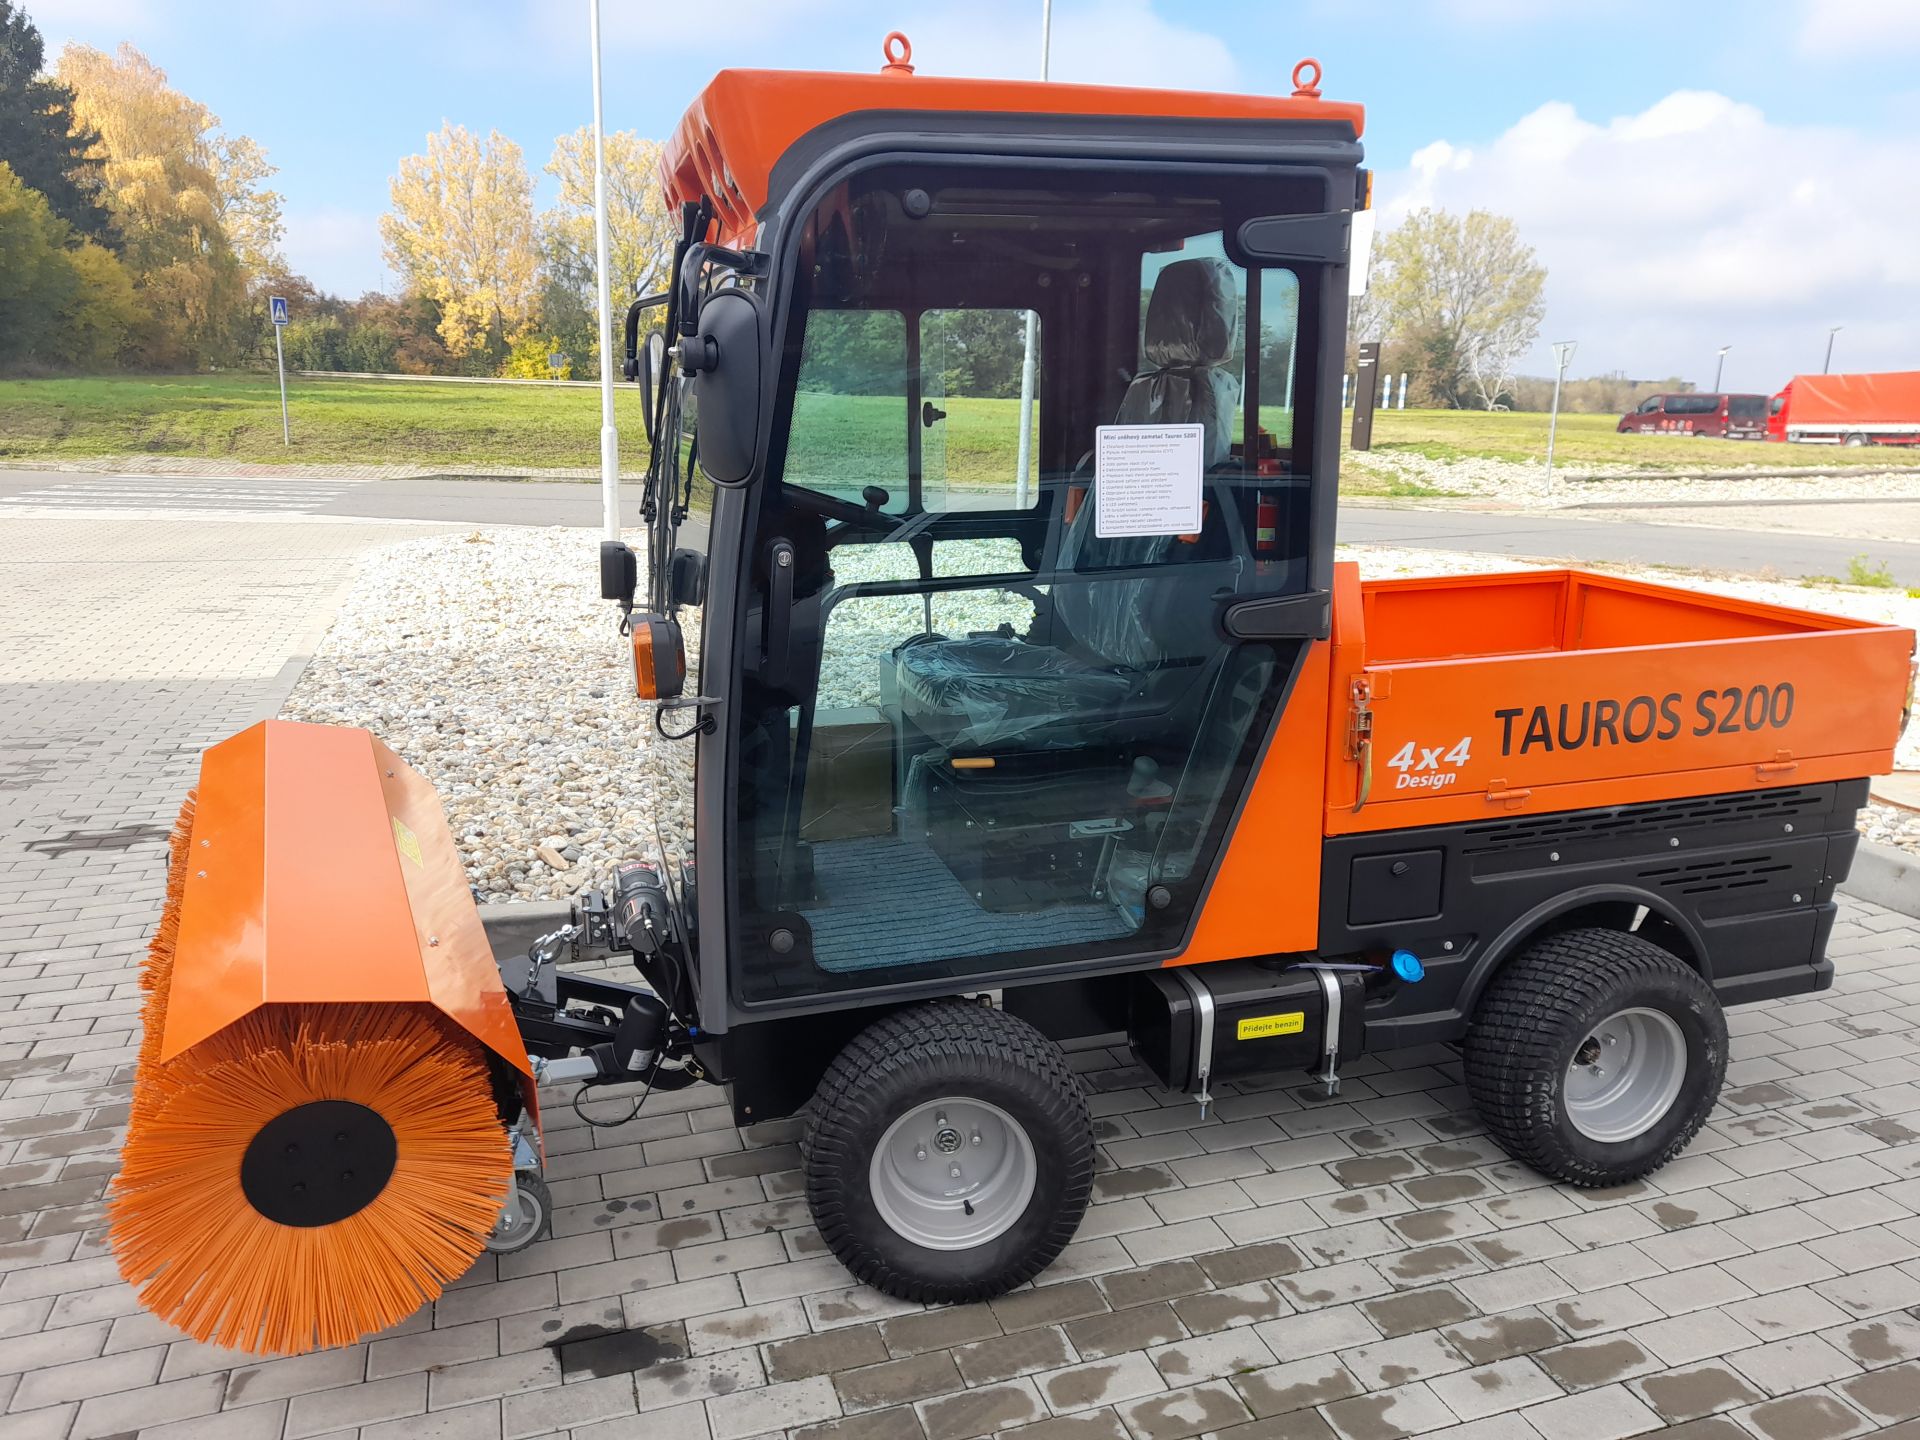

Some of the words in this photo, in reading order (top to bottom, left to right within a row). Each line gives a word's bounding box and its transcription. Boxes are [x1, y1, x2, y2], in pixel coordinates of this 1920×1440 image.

[1495, 692, 1682, 756] TAUROS
[1692, 682, 1795, 738] S200
[1387, 736, 1472, 772] 4x4
[1396, 770, 1457, 790] Design
